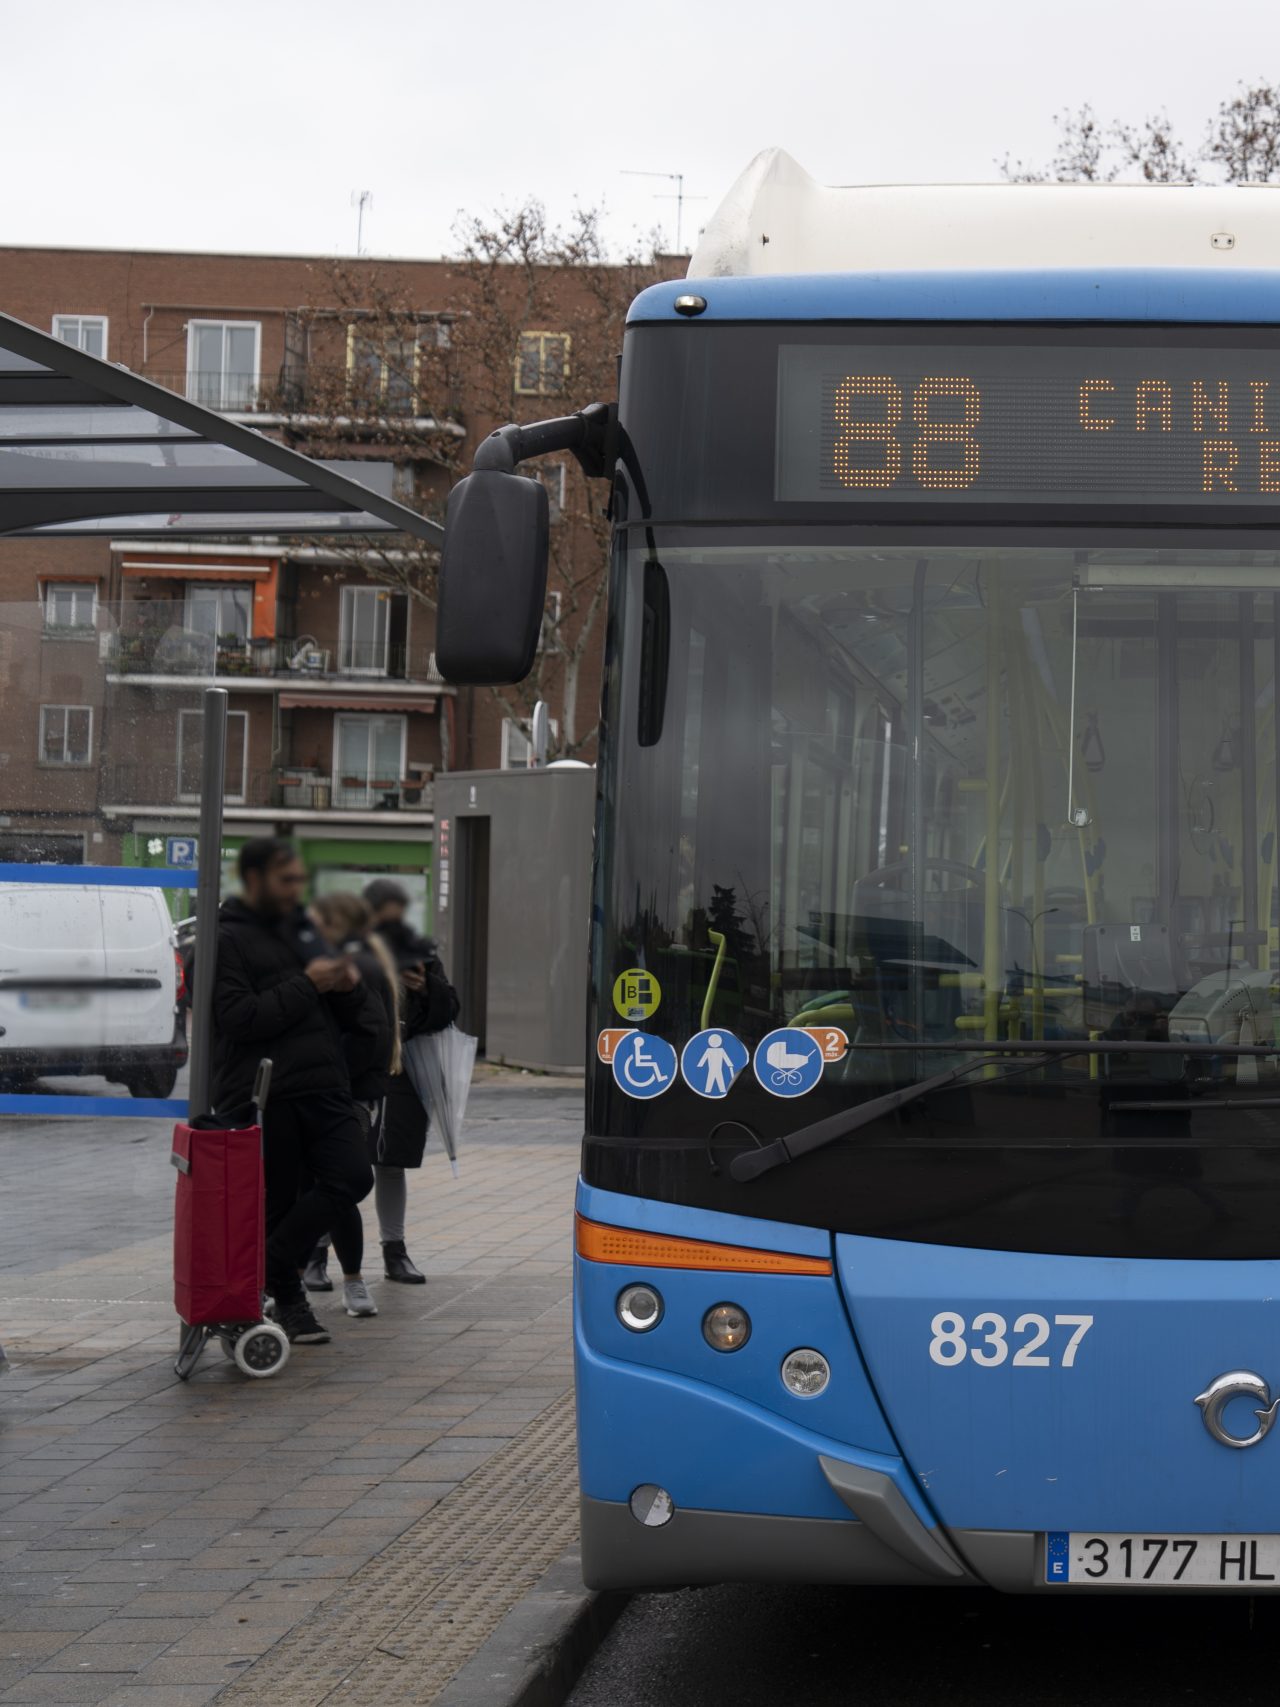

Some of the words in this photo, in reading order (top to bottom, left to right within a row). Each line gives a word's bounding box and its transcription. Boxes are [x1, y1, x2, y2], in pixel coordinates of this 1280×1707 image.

[834, 376, 980, 488] 88
[172, 841, 190, 863] P
[627, 985, 638, 999] B
[602, 1034, 609, 1053] 1
[825, 1032, 839, 1051] 2
[929, 1311, 1094, 1367] 8327
[1053, 1562, 1063, 1573] E
[1084, 1538, 1198, 1580] 3177
